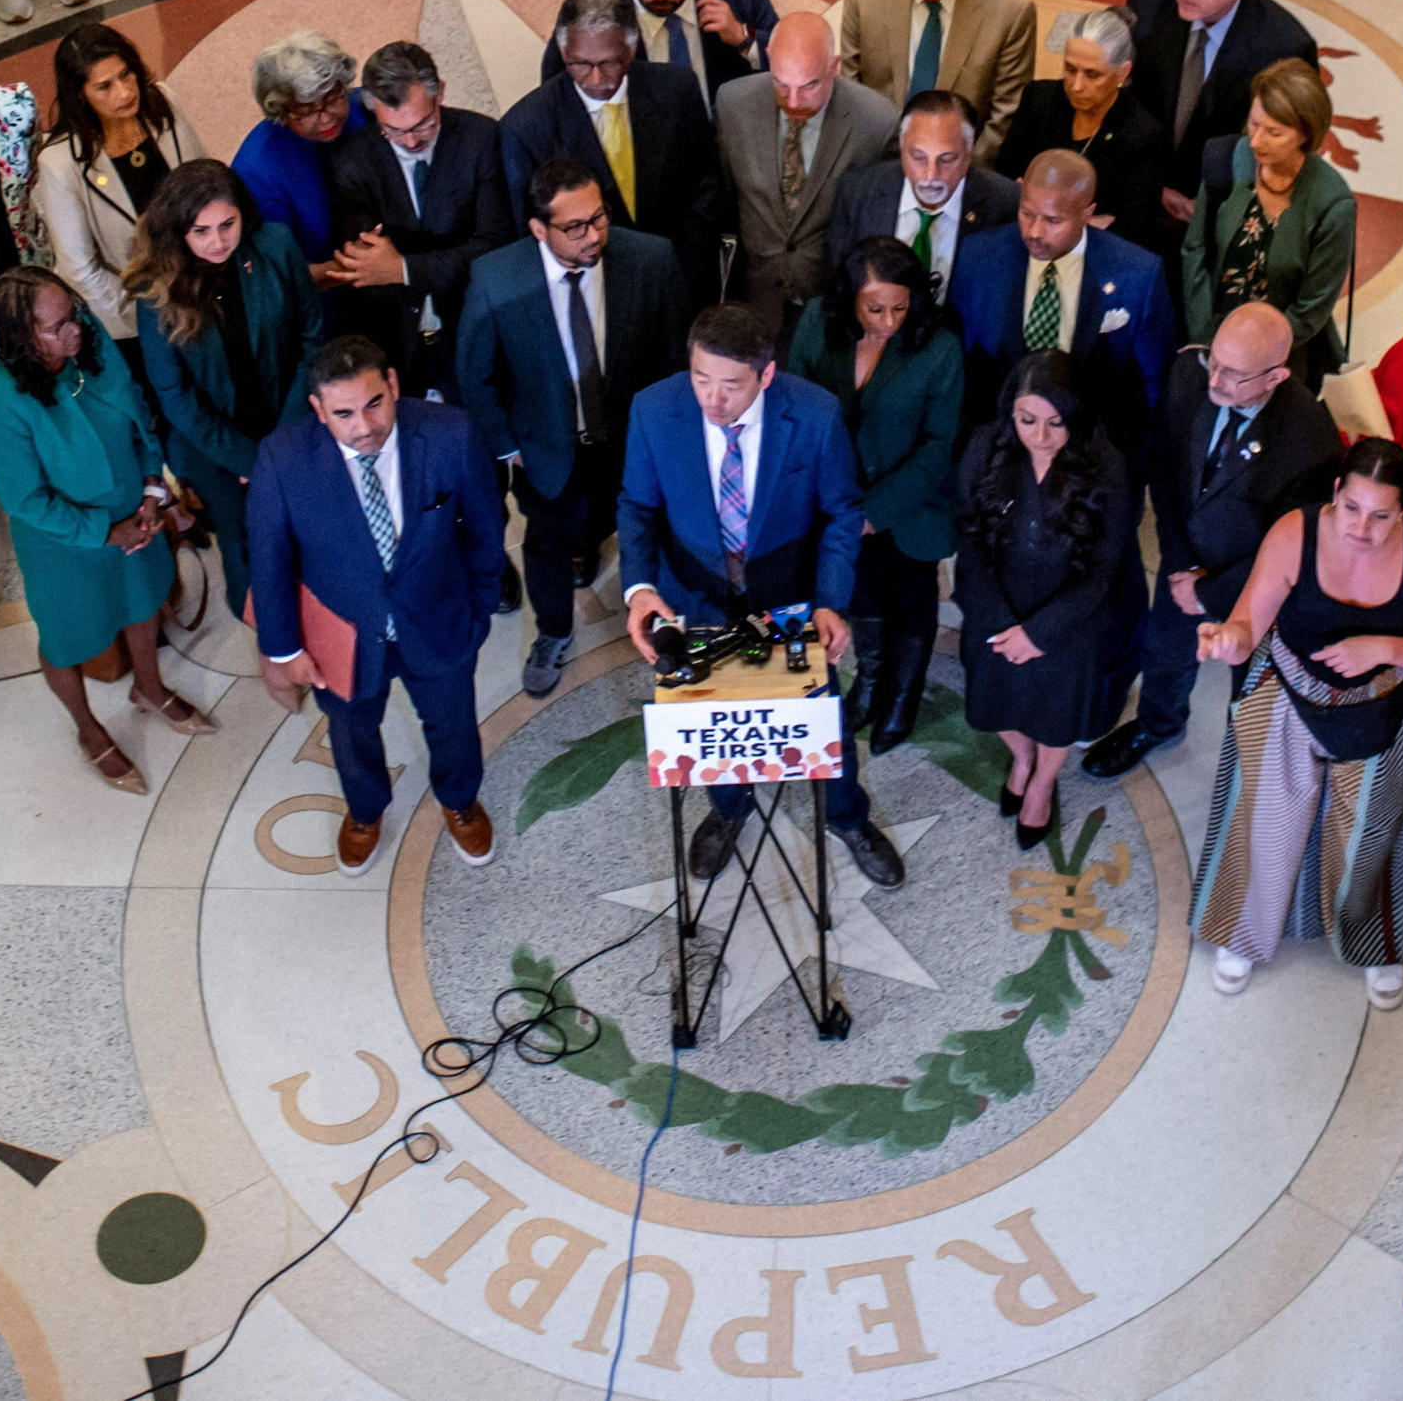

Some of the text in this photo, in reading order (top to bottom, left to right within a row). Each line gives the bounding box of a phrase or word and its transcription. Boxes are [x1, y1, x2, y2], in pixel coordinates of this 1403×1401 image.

[710, 709, 773, 726] PUT
[678, 723, 808, 743] TEXANS
[701, 741, 787, 759] FIRST
[269, 1049, 1096, 1380] REPUBLIC
